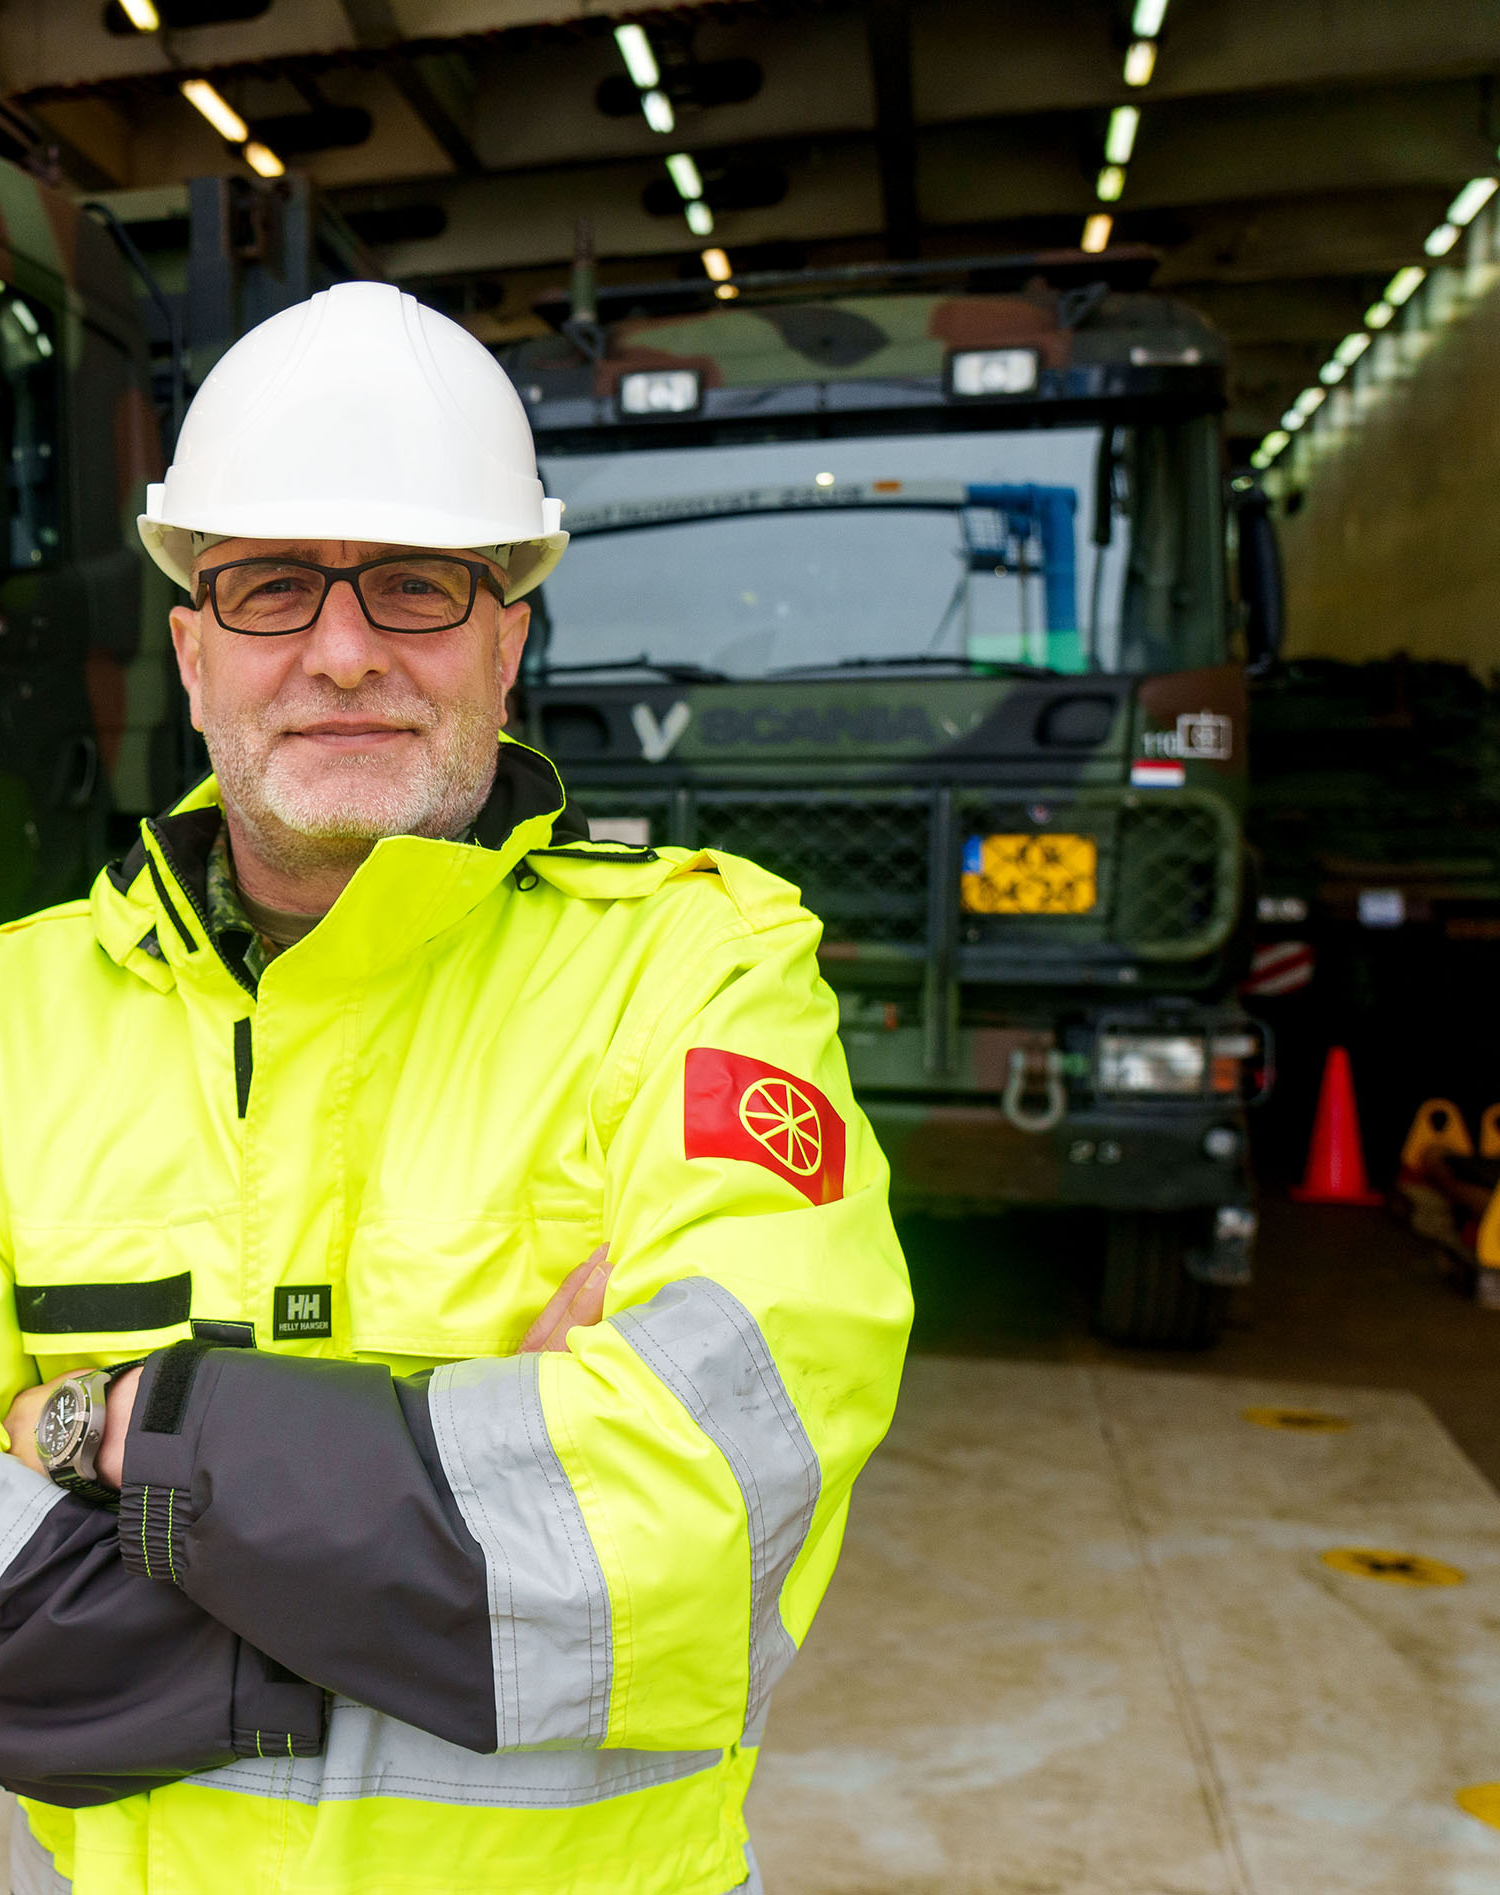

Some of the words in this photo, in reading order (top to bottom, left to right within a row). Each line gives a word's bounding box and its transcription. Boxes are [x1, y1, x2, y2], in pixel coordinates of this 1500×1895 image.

[700, 706, 936, 747] SCANIA
[278, 1322, 299, 1331] HELLY
[300, 1321, 329, 1330] HANSEN
